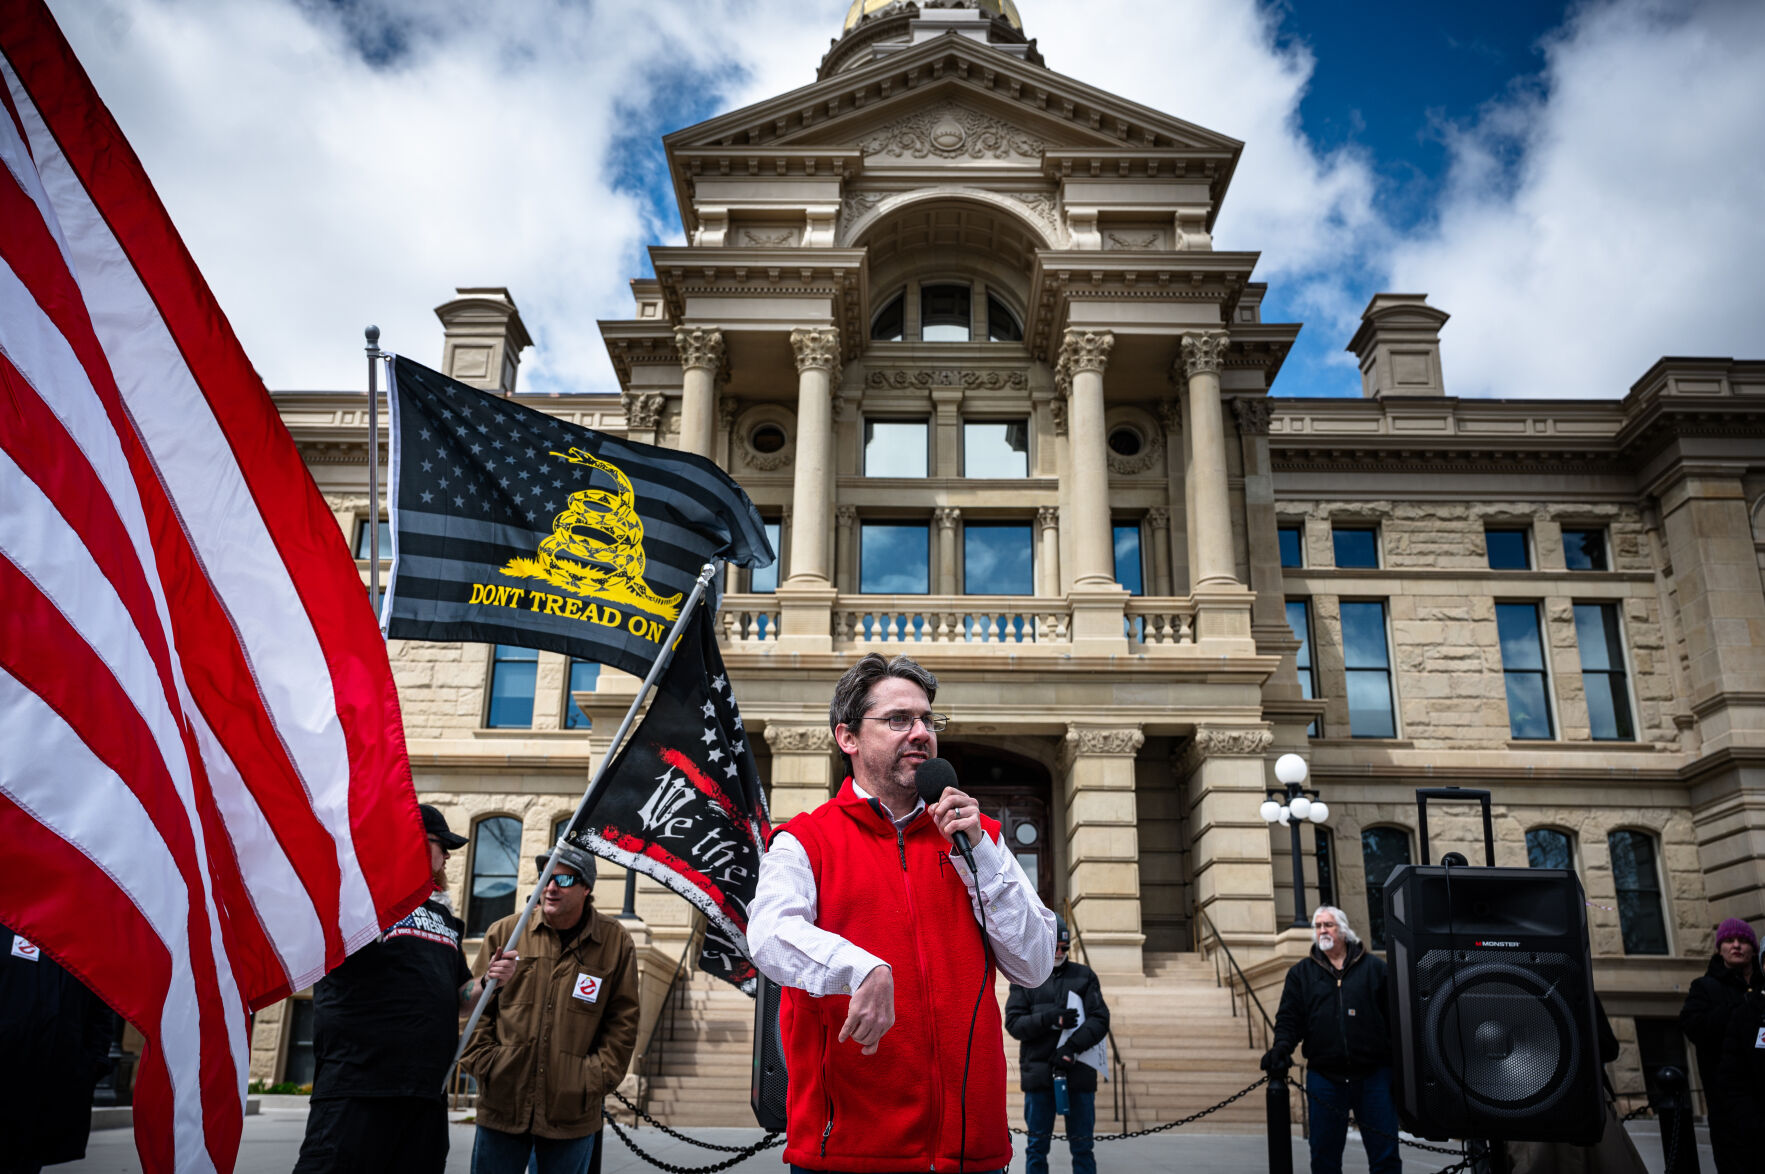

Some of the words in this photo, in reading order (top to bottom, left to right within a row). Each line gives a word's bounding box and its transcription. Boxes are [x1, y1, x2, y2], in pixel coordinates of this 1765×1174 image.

[469, 583, 525, 608] DONT
[529, 590, 622, 628] TREAD
[628, 615, 665, 644] ON
[637, 765, 697, 838] We
[691, 827, 748, 885] the
[412, 906, 430, 919] NOT
